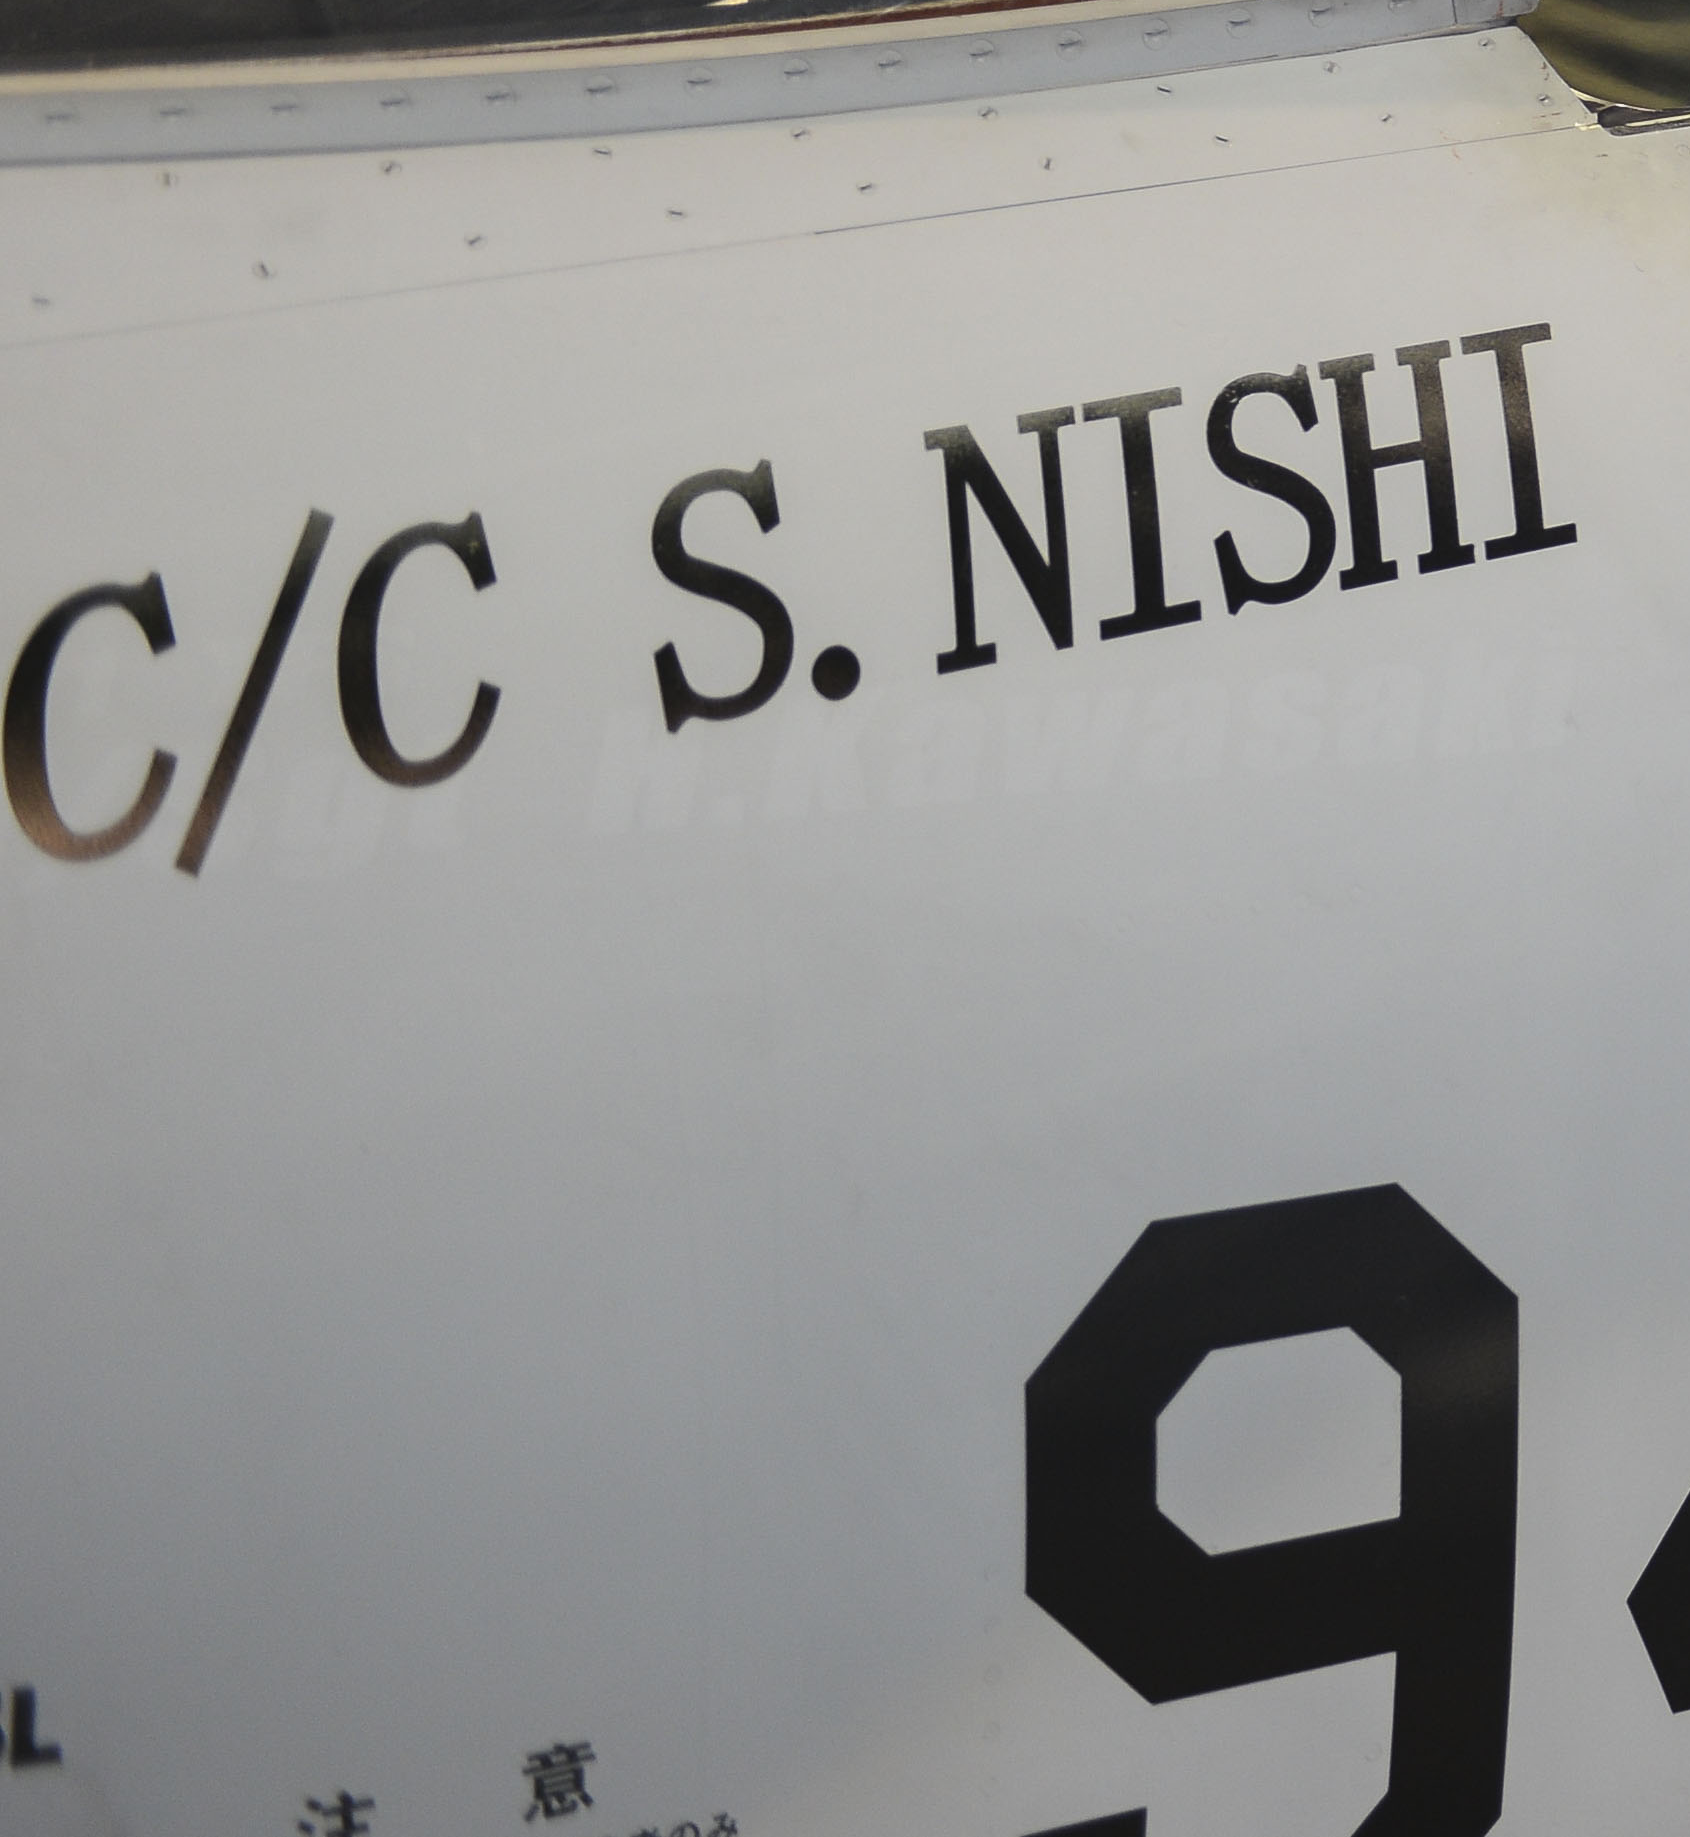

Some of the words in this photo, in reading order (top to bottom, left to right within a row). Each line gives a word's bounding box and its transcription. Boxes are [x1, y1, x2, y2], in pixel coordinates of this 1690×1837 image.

[3, 508, 502, 878] C/C
[923, 321, 1579, 675] NISHI
[0, 1683, 63, 1767] L
